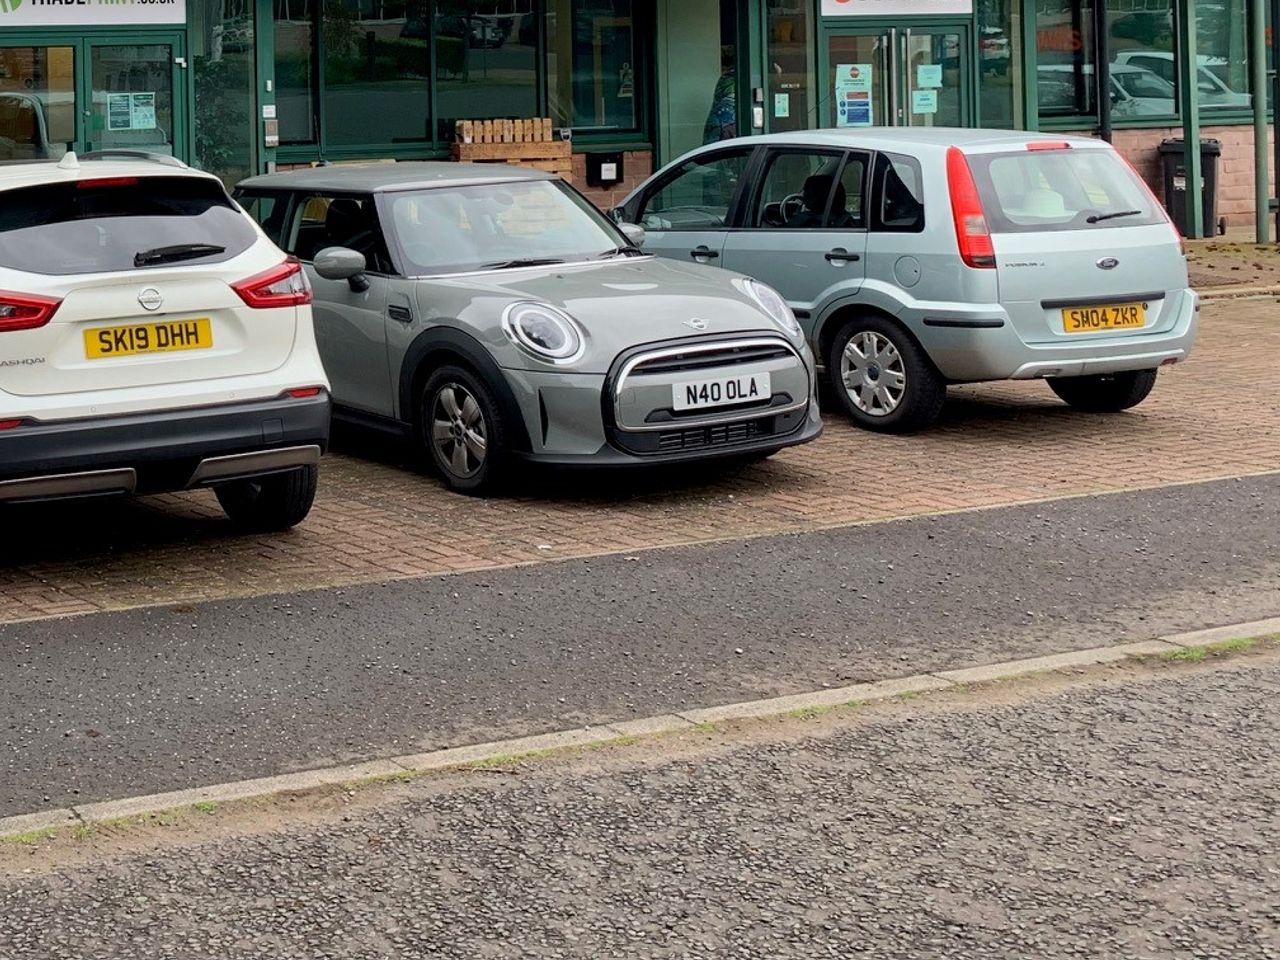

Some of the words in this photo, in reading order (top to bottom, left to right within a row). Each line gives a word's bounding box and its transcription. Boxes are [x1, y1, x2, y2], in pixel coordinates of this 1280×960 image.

[1070, 308, 1109, 329] SM04
[1112, 307, 1139, 325] ZKR
[99, 327, 150, 353] SK19
[155, 323, 199, 348] DHH
[686, 382, 721, 405] N40
[726, 377, 759, 400] OLA
